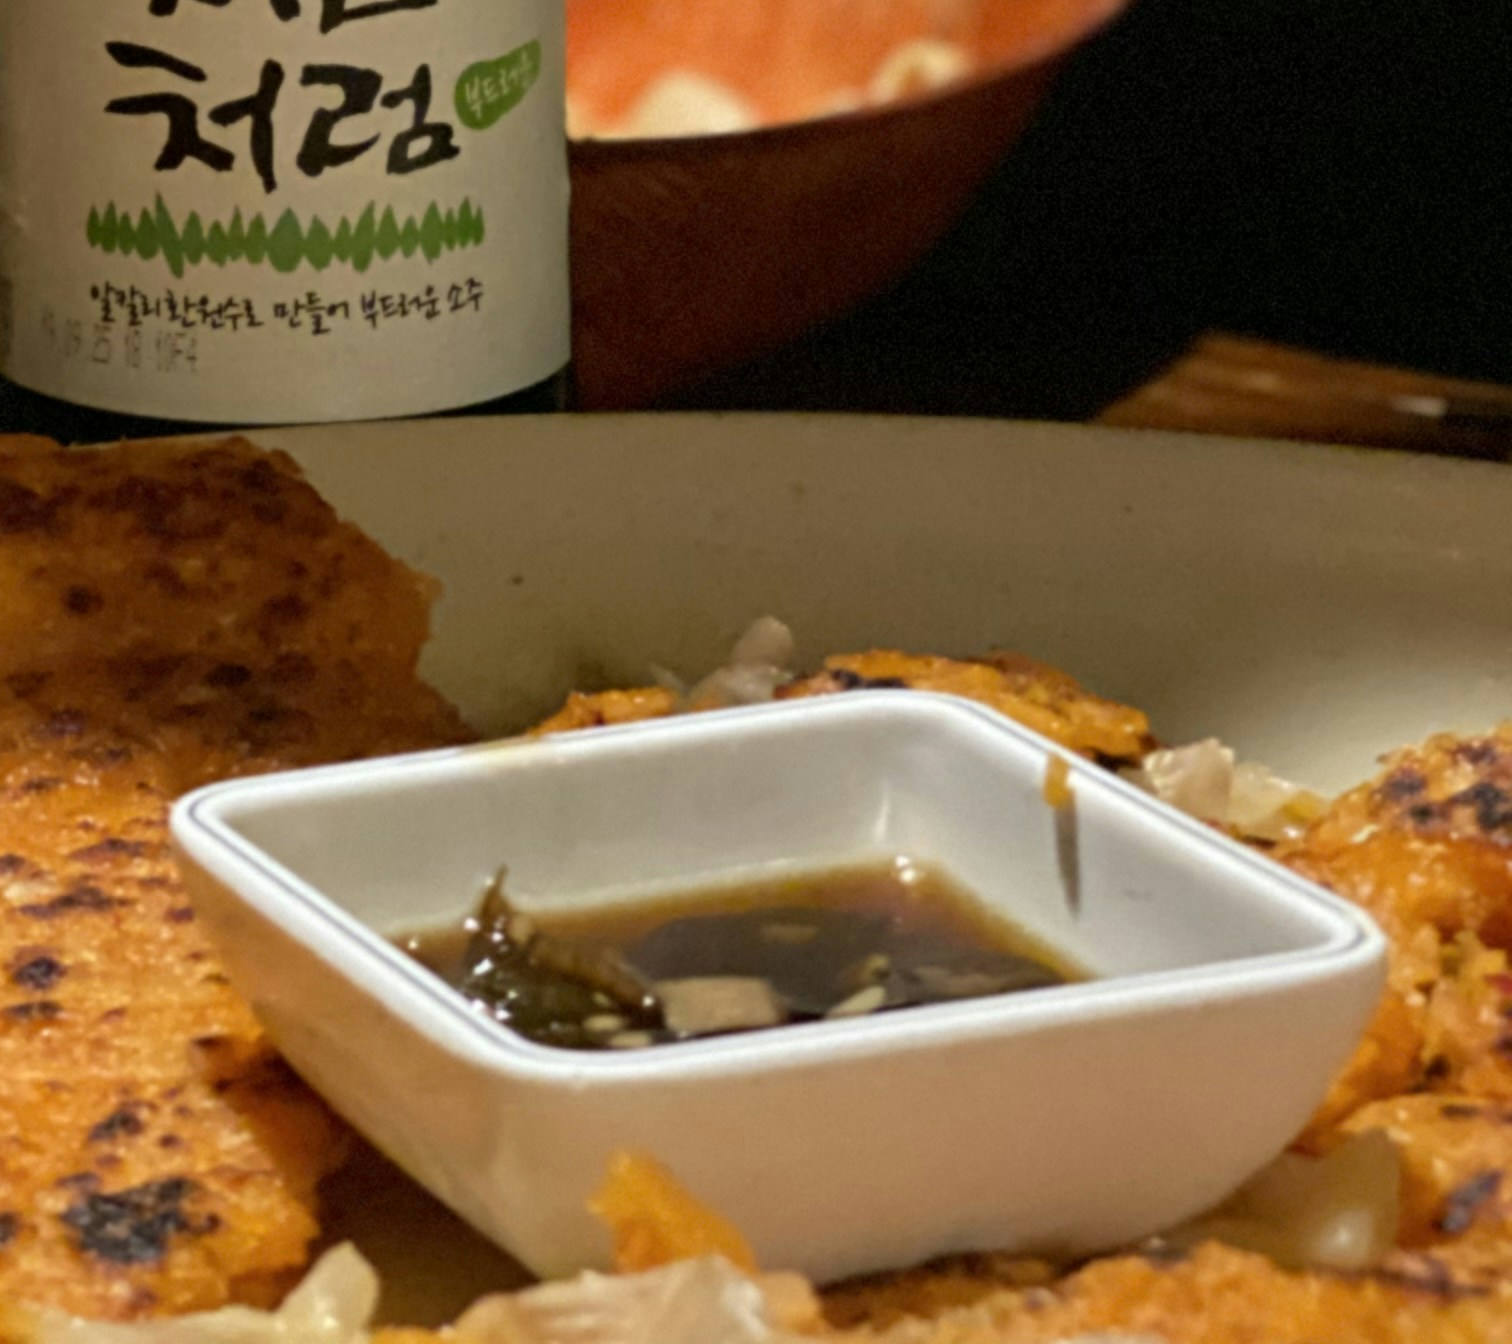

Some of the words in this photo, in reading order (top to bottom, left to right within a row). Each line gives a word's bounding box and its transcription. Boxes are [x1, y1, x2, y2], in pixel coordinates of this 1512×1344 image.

[104, 40, 461, 194] 처럼
[89, 281, 265, 331] 알칼리환원수로
[273, 291, 350, 336] 만들어
[360, 285, 441, 328] 부드러운
[447, 277, 485, 313] 소주
